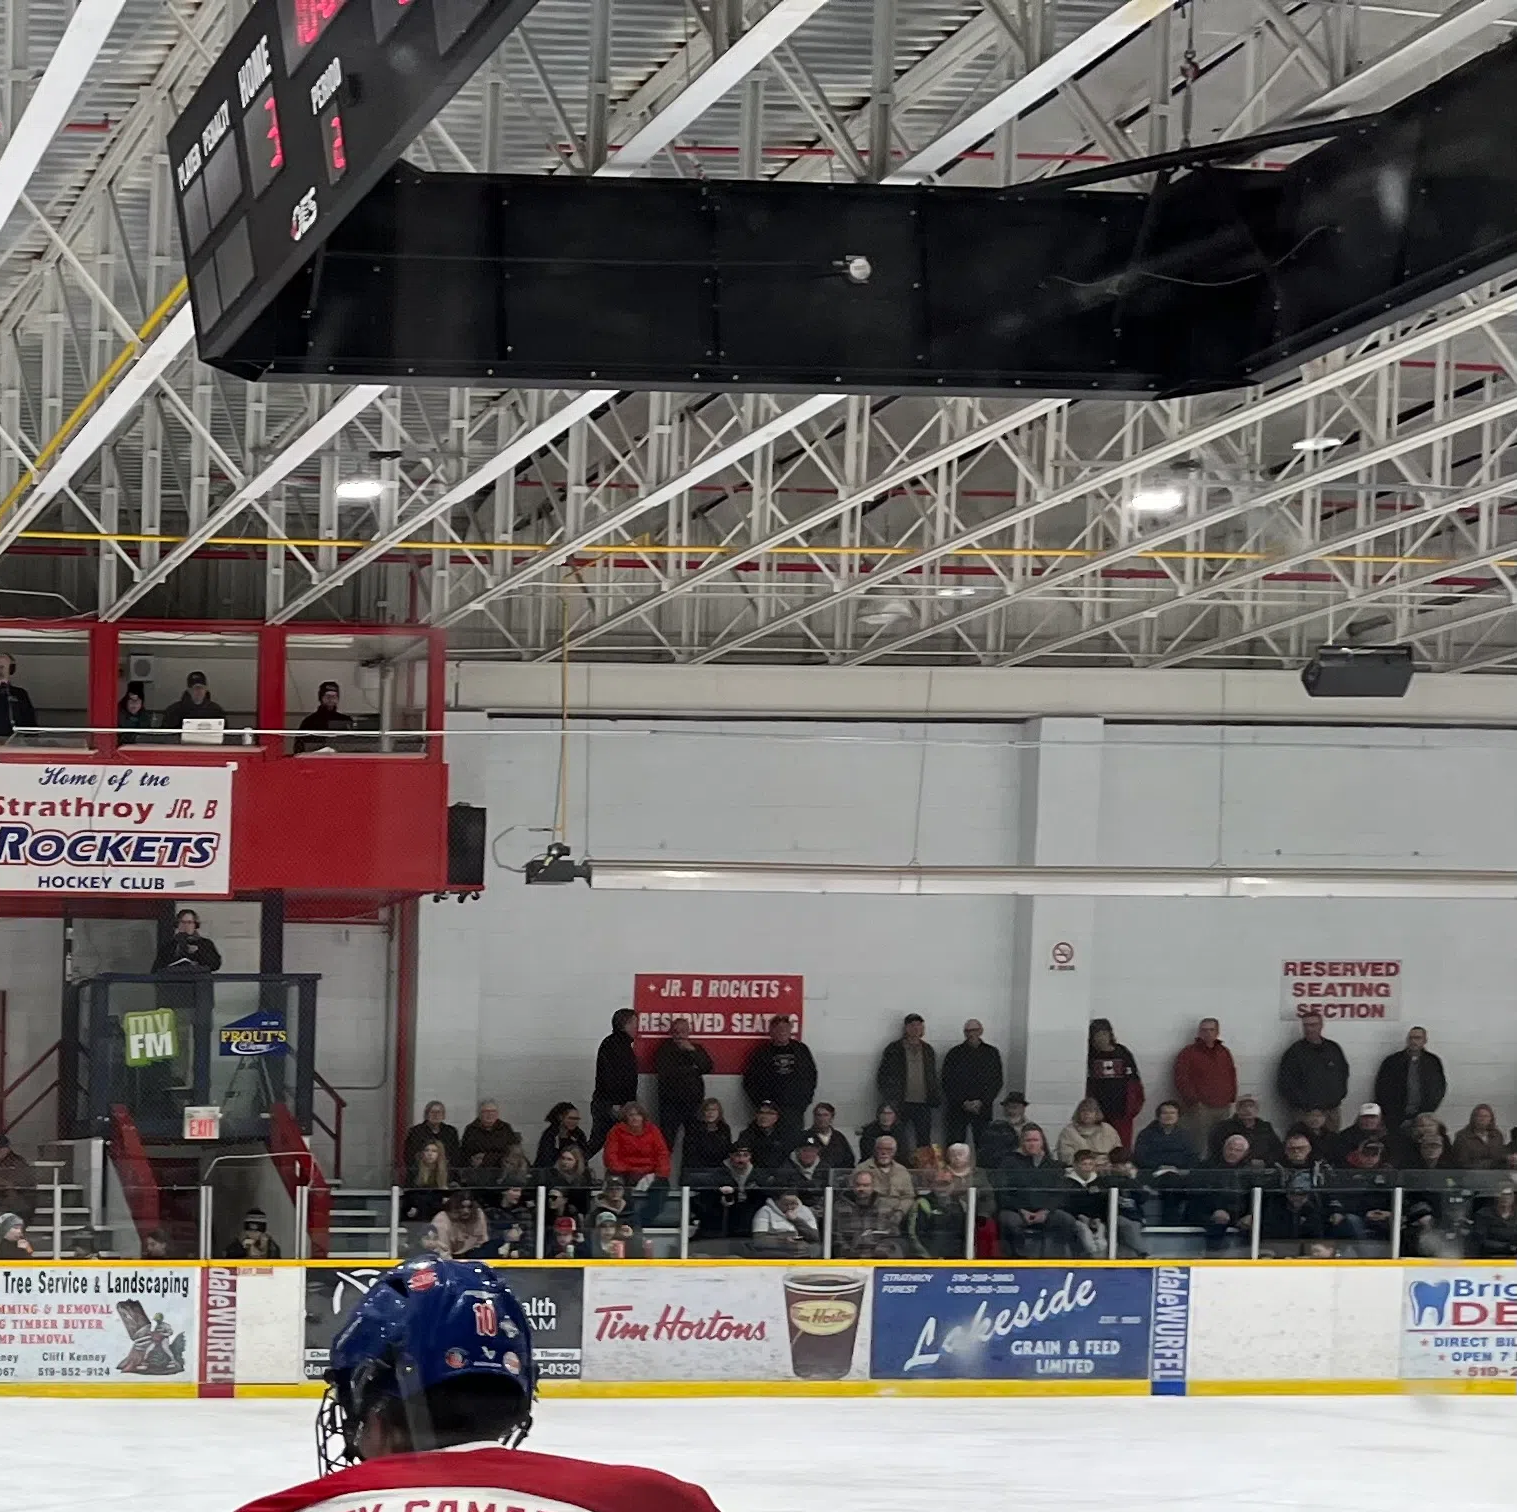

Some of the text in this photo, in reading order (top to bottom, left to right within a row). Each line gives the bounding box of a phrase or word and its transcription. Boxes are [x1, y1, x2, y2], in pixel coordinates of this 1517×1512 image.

[238, 35, 272, 108] HOME
[311, 57, 342, 115] PERIOD
[38, 767, 96, 786] Home
[108, 769, 130, 791] of
[165, 799, 195, 820] JR.
[203, 800, 218, 819] B
[38, 876, 165, 890] HOCKEY CLUB
[1284, 962, 1400, 976] RESERVED
[661, 980, 779, 998] JR. B ROCKETS
[1292, 982, 1391, 997] SEATING
[128, 1013, 170, 1035] my
[130, 1033, 173, 1058] FM
[190, 1119, 215, 1137] EXIT
[4, 1272, 32, 1294] Tree
[39, 1272, 88, 1294] Service
[94, 1276, 100, 1293] &
[107, 1271, 189, 1298] Landscaping
[57, 1305, 113, 1315] REMOVAL
[11, 1320, 58, 1329] TIMBER
[63, 1320, 105, 1329] BUYER
[594, 1303, 767, 1341] Tim Hortons
[20, 1334, 75, 1344] REMOVAL
[1434, 1337, 1489, 1347] DIRECT
[1011, 1340, 1120, 1355] GRAIN & FEED
[42, 1352, 106, 1363] Cliff Kenney
[1451, 1352, 1509, 1361] OPEN 7
[1036, 1359, 1095, 1373] LIMITED
